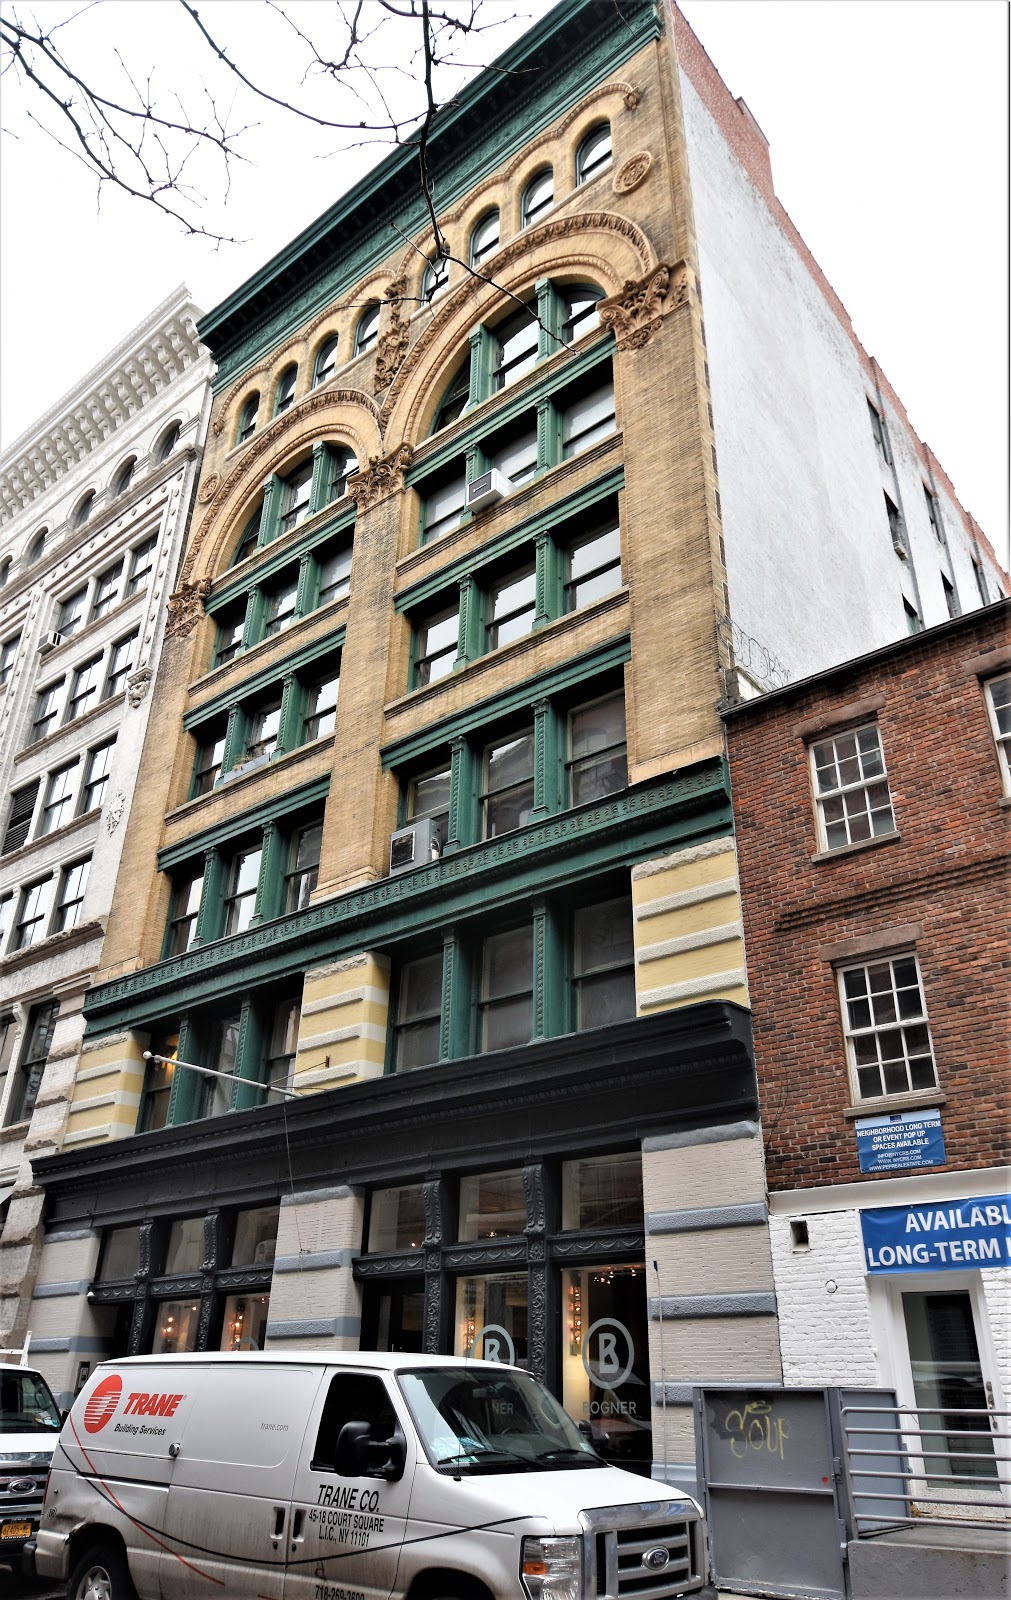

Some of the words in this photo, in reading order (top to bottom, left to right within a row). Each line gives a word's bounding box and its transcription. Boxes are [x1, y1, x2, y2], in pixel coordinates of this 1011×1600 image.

[856, 1125, 905, 1138] NEIGHBORHOOD
[905, 1122, 923, 1131] LONG
[924, 1120, 941, 1128] TERM
[883, 1133, 903, 1142] EVENT
[896, 1138, 930, 1149] AVAILABLE
[867, 1237, 1002, 1267] LONG-TERM
[123, 1392, 184, 1417] TRANE
[583, 1401, 637, 1415] BOGNER
[114, 1423, 139, 1435] Building
[139, 1425, 167, 1436] Services
[260, 1422, 289, 1431] trane.com
[317, 1484, 359, 1509] TRANE
[359, 1489, 380, 1512] CO.
[308, 1508, 327, 1524] 45-18
[327, 1511, 352, 1527] COURT
[353, 1514, 385, 1532] SQUARE
[338, 1528, 350, 1543] NY
[350, 1530, 370, 1547] 11101
